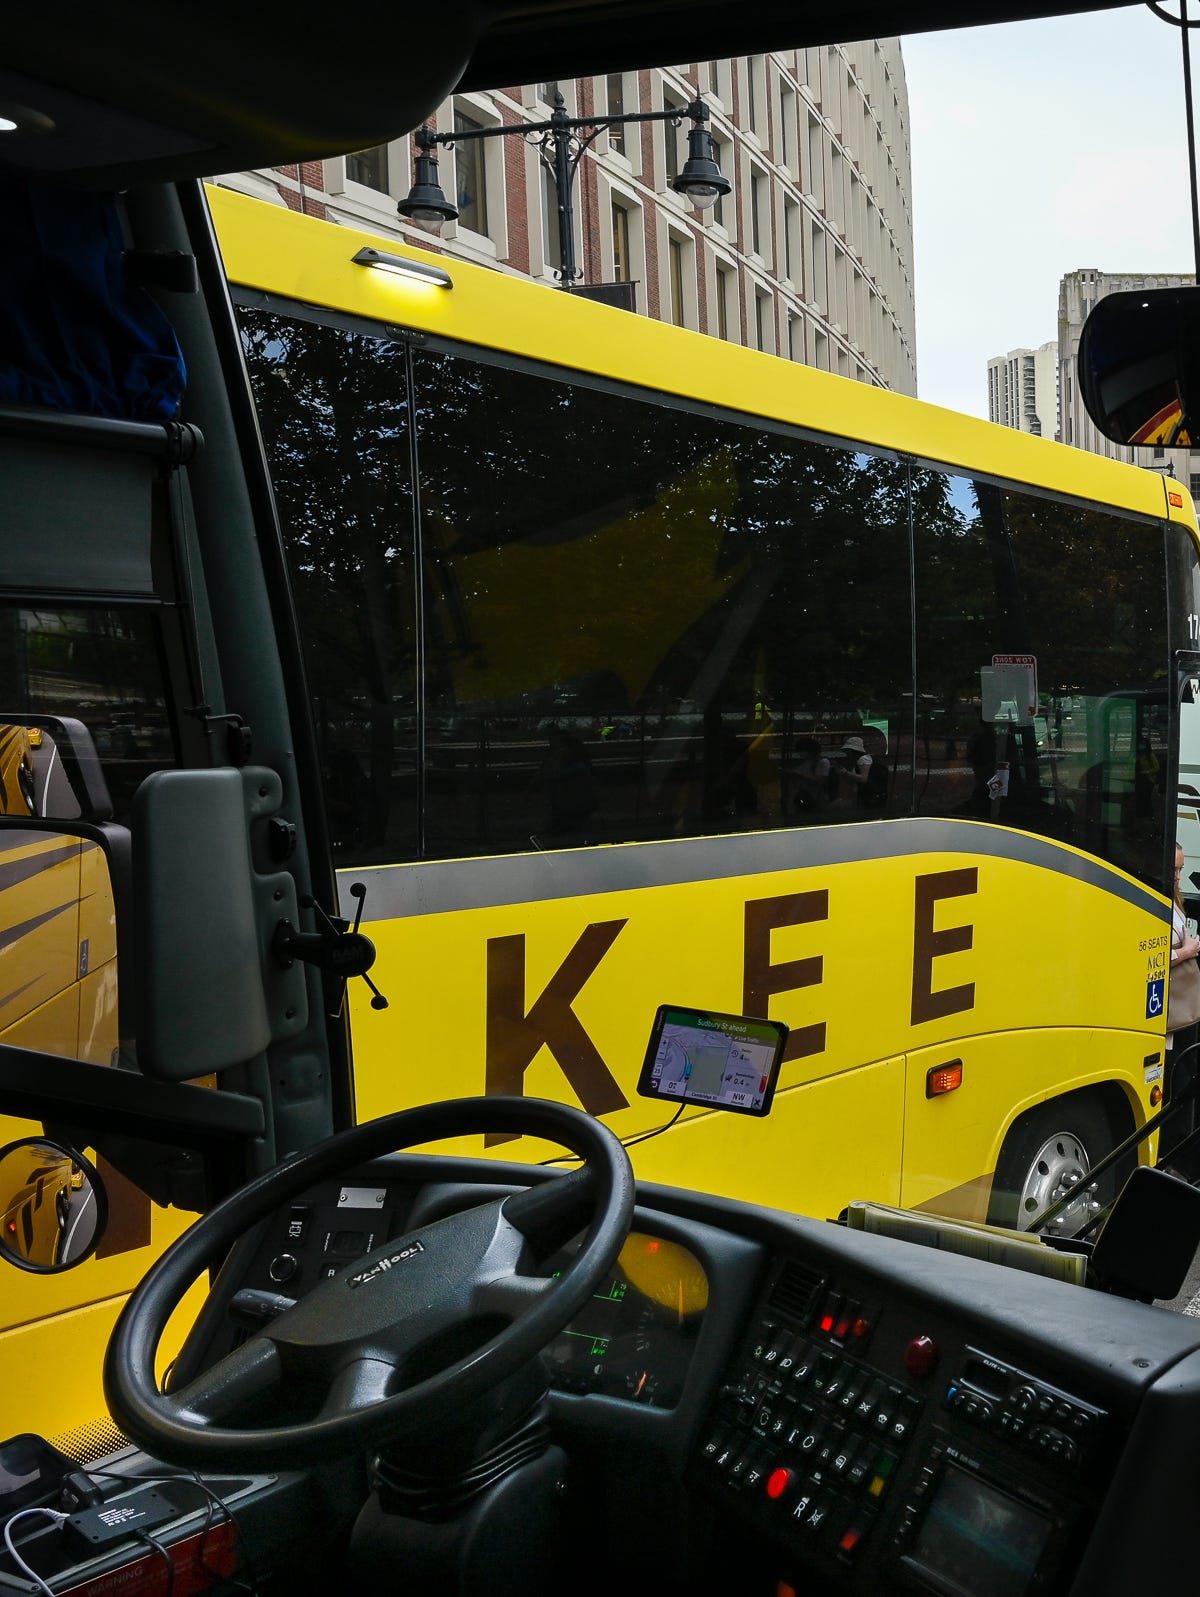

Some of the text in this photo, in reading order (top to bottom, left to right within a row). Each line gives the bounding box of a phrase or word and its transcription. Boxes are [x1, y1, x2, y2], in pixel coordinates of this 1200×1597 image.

[1138, 935, 1168, 952] 56 SEATS
[1147, 951, 1166, 971] MCI
[697, 1018, 747, 1033] Sudbury St ahead
[732, 1092, 746, 1102] NW
